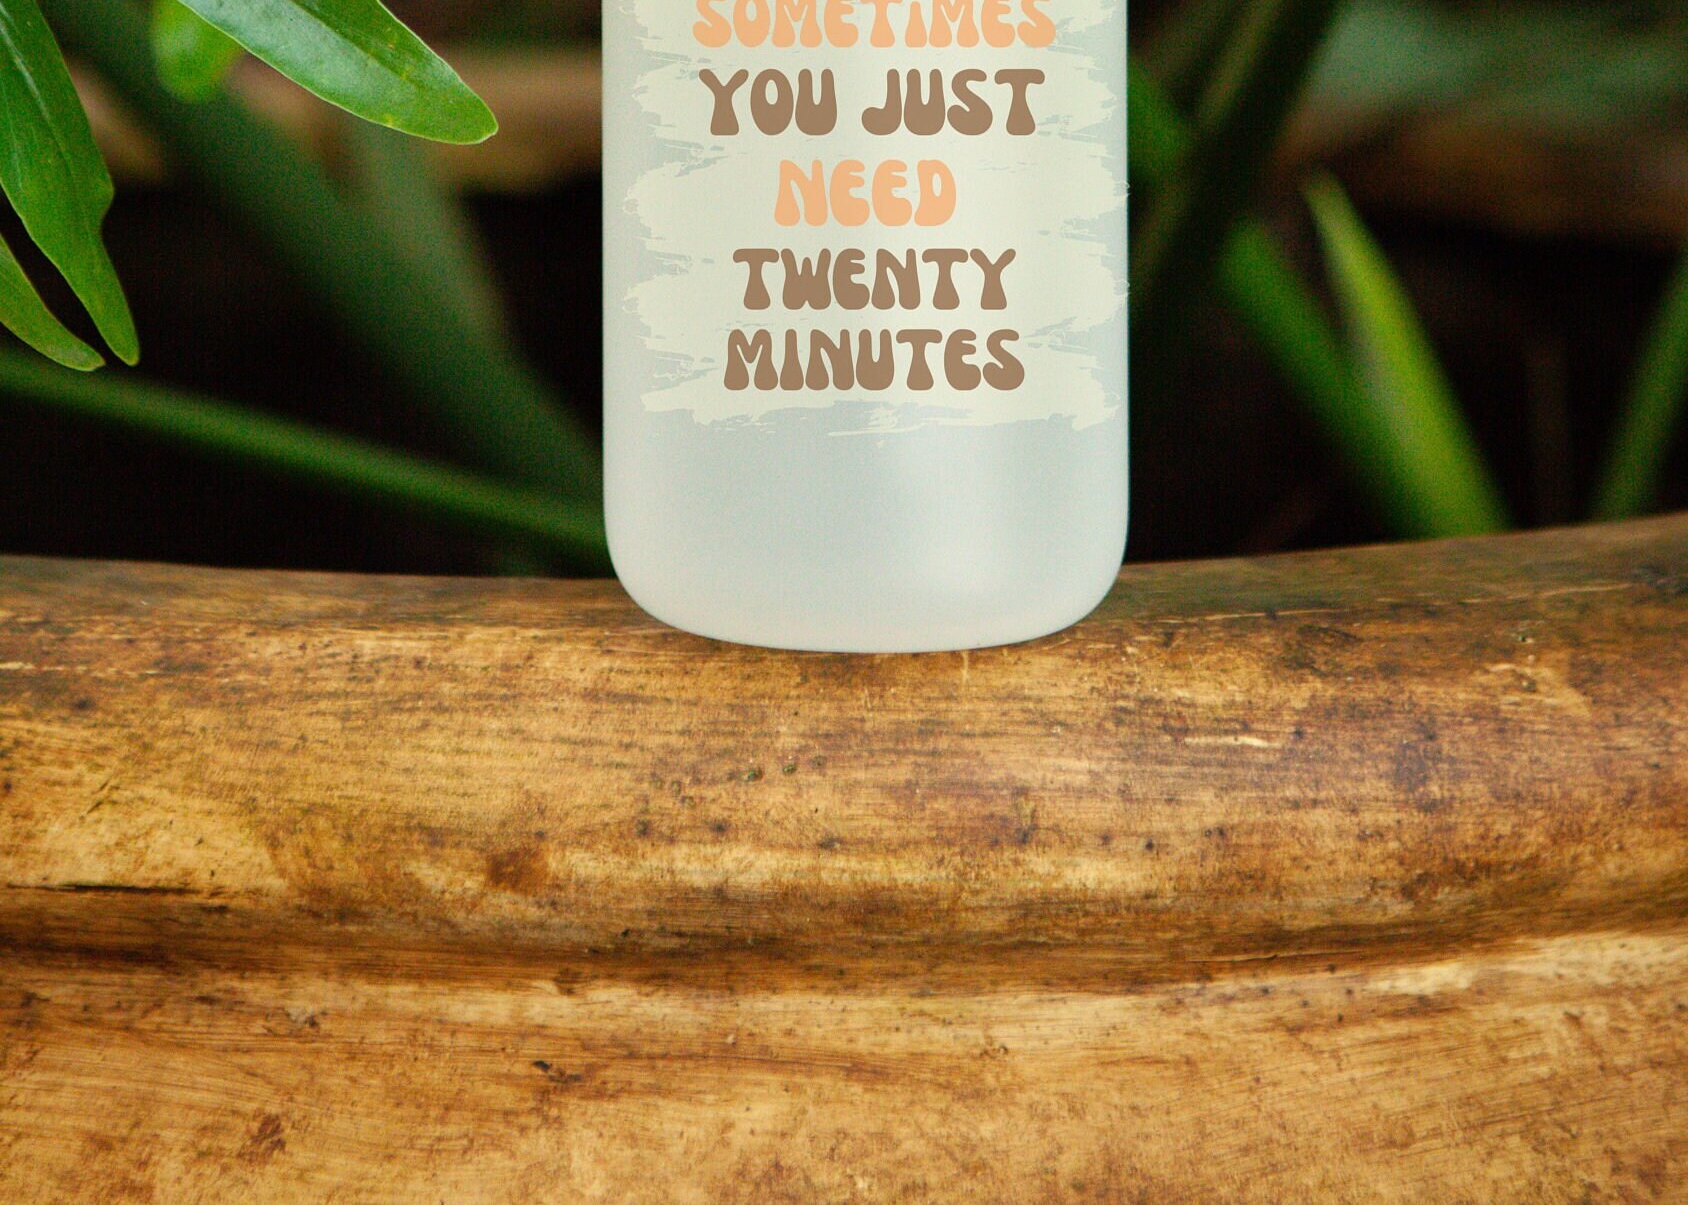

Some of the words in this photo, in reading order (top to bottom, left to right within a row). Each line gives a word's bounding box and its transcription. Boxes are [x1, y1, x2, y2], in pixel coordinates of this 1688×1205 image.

[699, 68, 838, 136] YOU
[861, 68, 1046, 136] JUST
[774, 159, 957, 228] NEED
[732, 248, 1016, 311] TWENTY
[723, 329, 1025, 391] MINUTES
